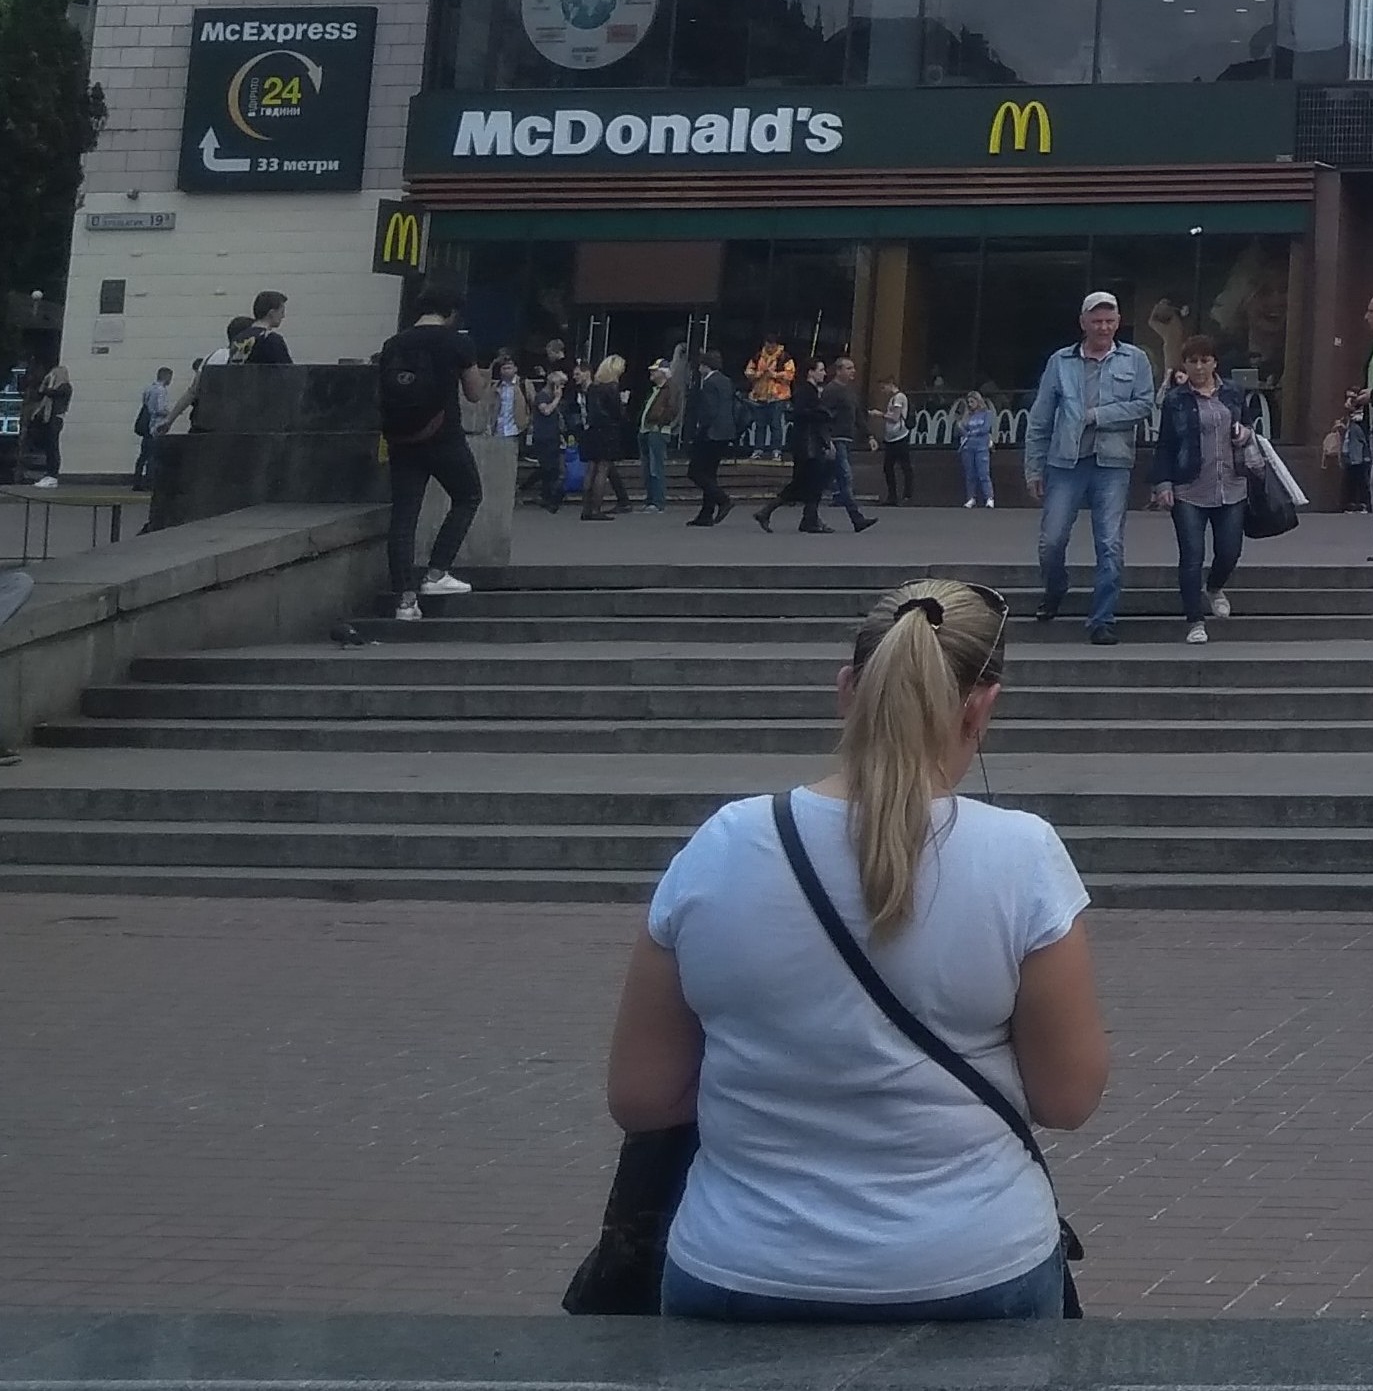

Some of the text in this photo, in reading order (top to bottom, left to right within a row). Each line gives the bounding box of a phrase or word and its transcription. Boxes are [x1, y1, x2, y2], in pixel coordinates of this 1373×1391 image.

[200, 21, 358, 43] McExpress
[262, 76, 302, 105] 24
[453, 107, 844, 157] McDonald's
[257, 158, 339, 172] 33 метри
